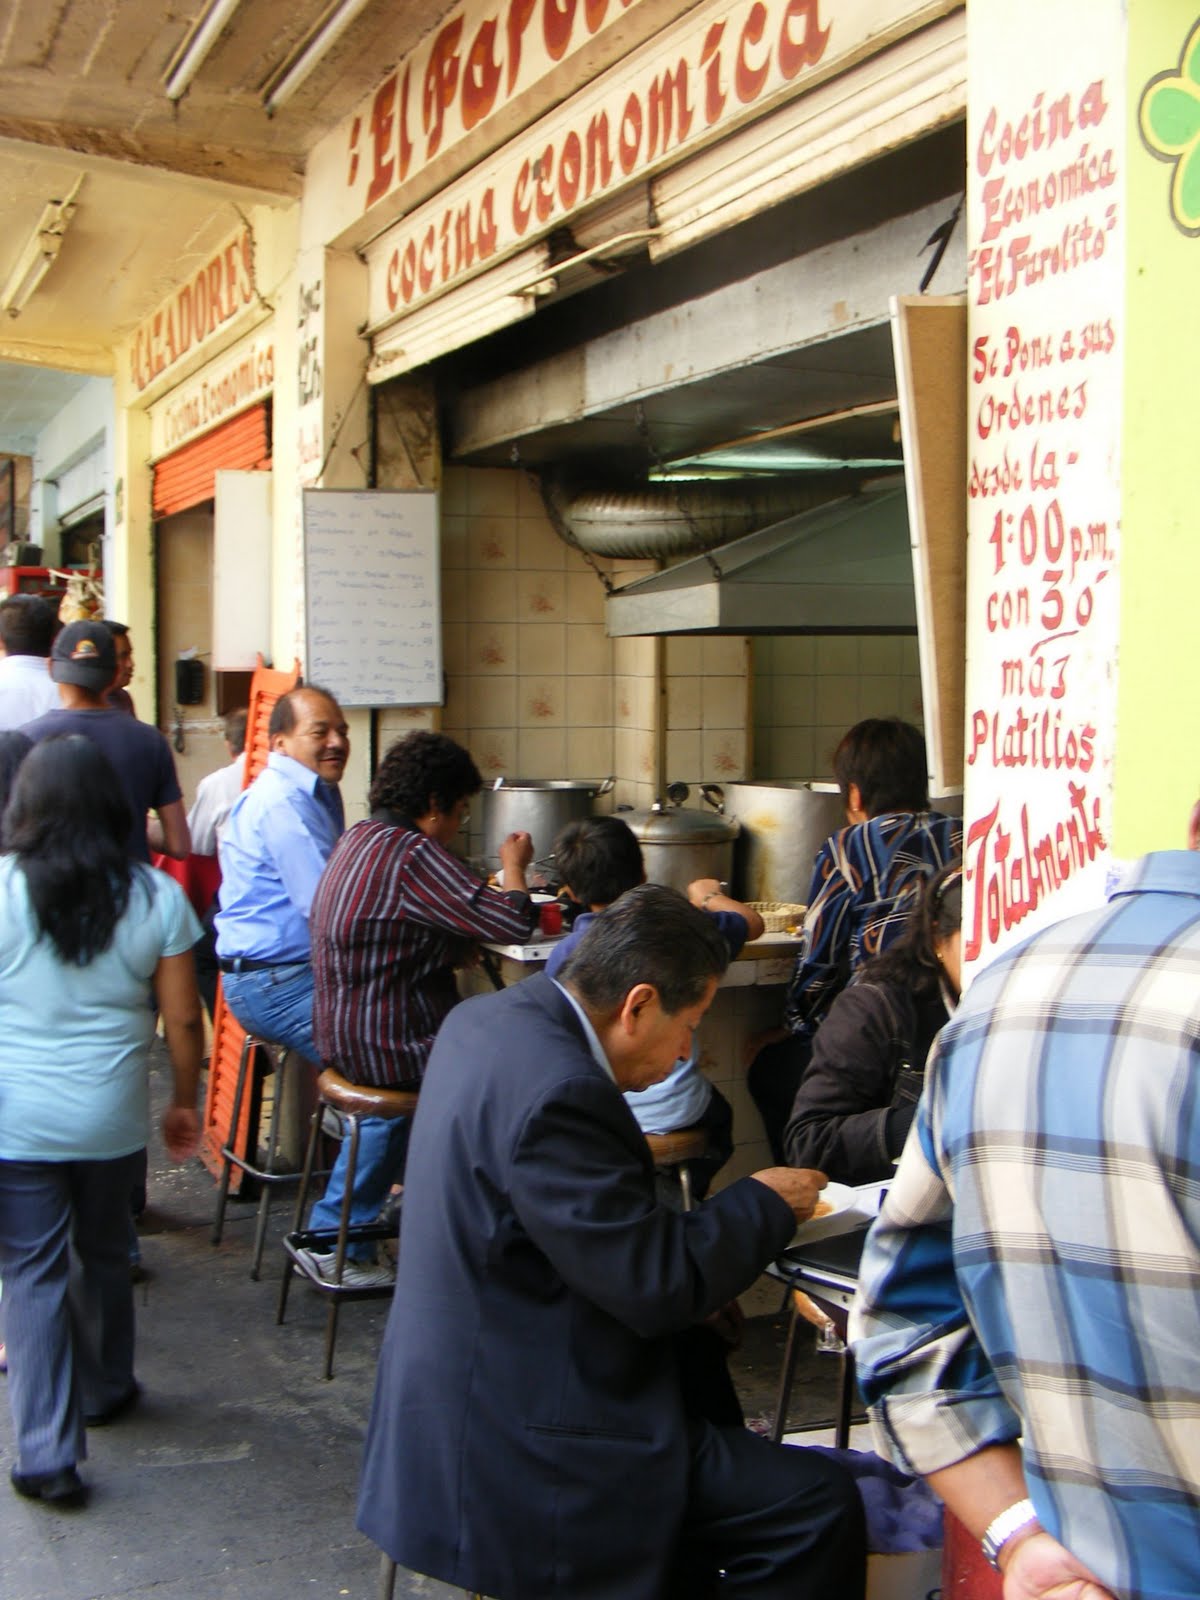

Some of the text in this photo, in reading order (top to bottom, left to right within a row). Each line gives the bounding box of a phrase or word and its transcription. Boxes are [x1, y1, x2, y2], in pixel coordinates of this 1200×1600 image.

[422, 0, 635, 163] Faro
[976, 79, 1108, 177] Cocina
[981, 143, 1117, 242] Economica
[387, 186, 497, 311] cocina
[973, 317, 1115, 384] Se Pone a sus
[977, 379, 1088, 440] Ordenes
[968, 444, 1022, 498] desde
[987, 586, 1030, 632] con
[1040, 569, 1064, 630] 3
[964, 780, 1107, 962] Totalmente
